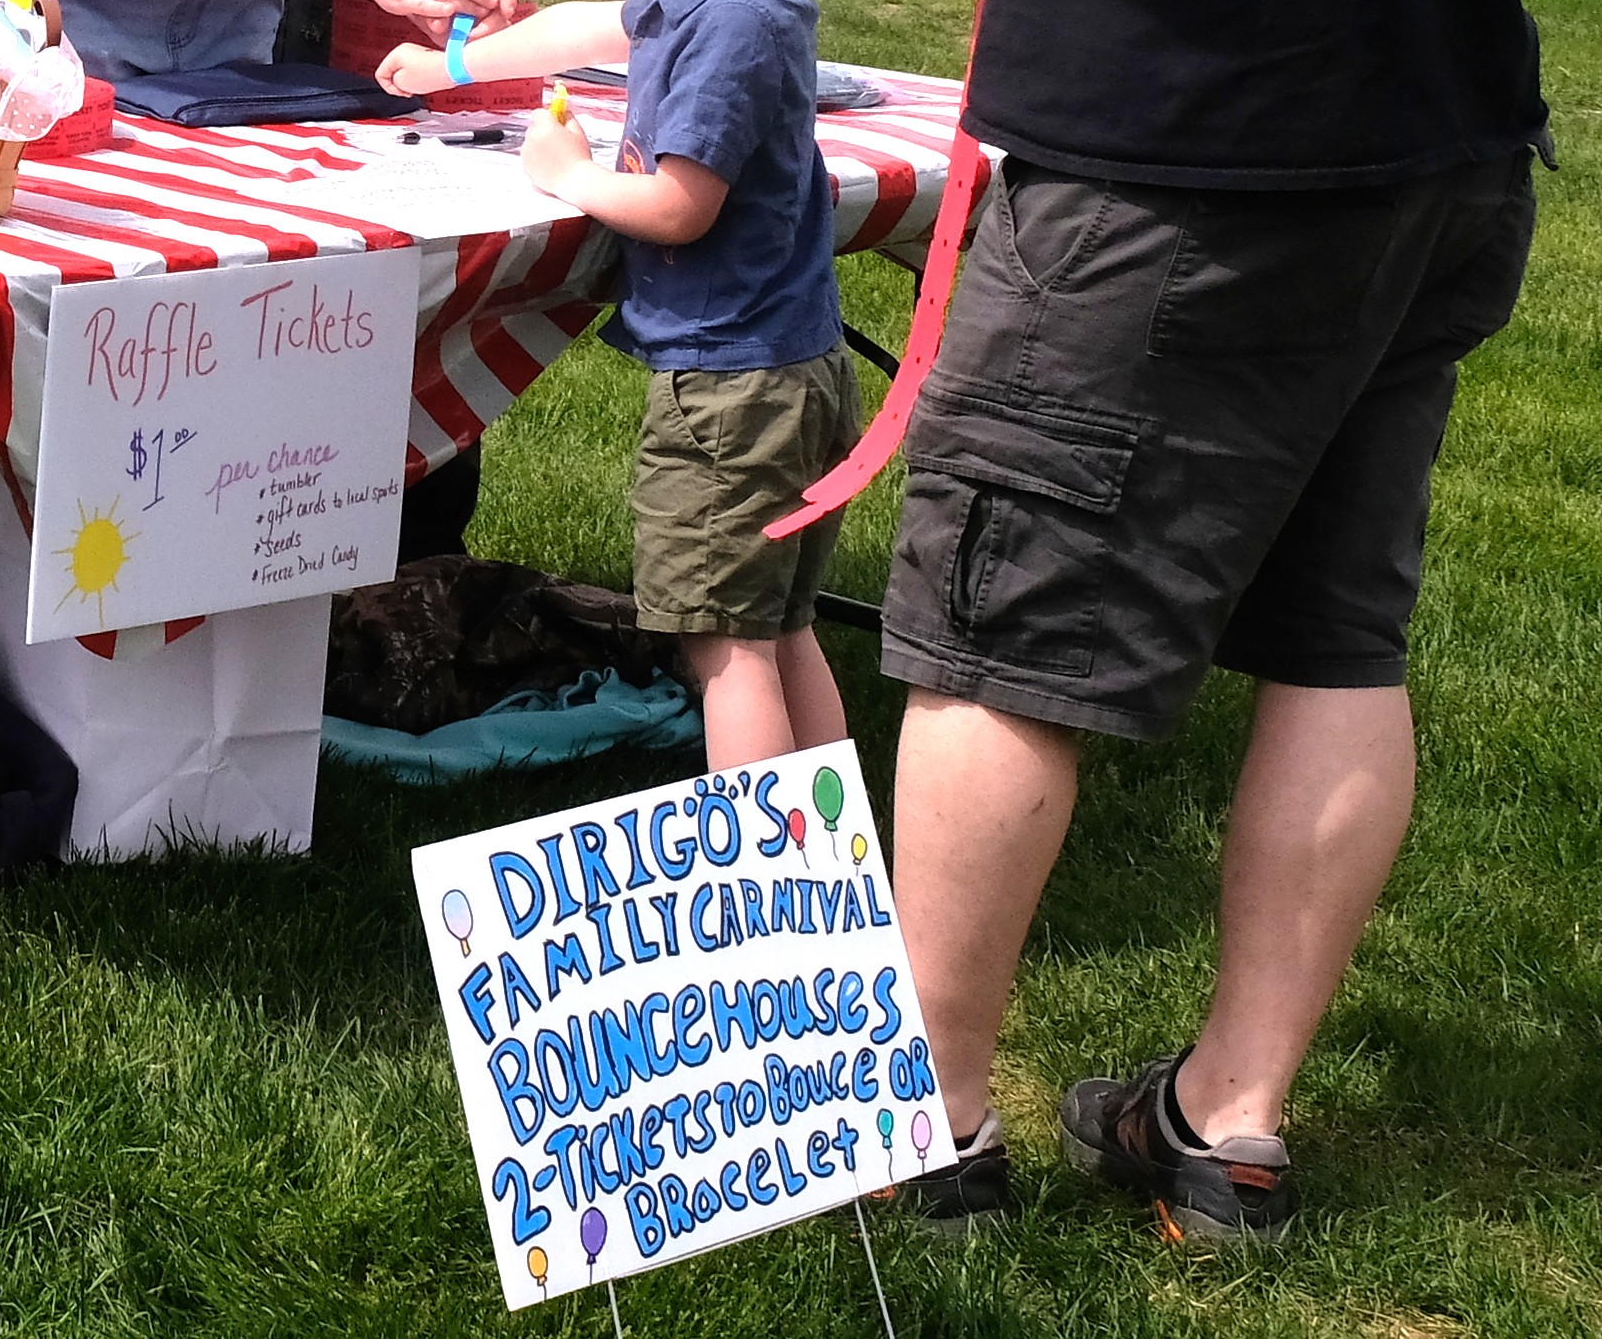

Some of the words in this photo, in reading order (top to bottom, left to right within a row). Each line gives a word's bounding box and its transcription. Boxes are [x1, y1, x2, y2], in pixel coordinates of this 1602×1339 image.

[84, 302, 217, 406] Raffle
[241, 280, 375, 360] Tickets
[205, 459, 262, 514] per
[267, 442, 340, 473] chance
[270, 471, 322, 496] tumbler
[265, 495, 293, 535] gift
[296, 489, 326, 518] cards
[333, 491, 343, 508] to
[261, 564, 294, 585] Freeze
[298, 551, 325, 575] Dried
[331, 545, 359, 570] Candy
[459, 891, 681, 1044] FAMILY
[689, 874, 892, 952] CARNIVAL
[889, 1036, 937, 1101] OR
